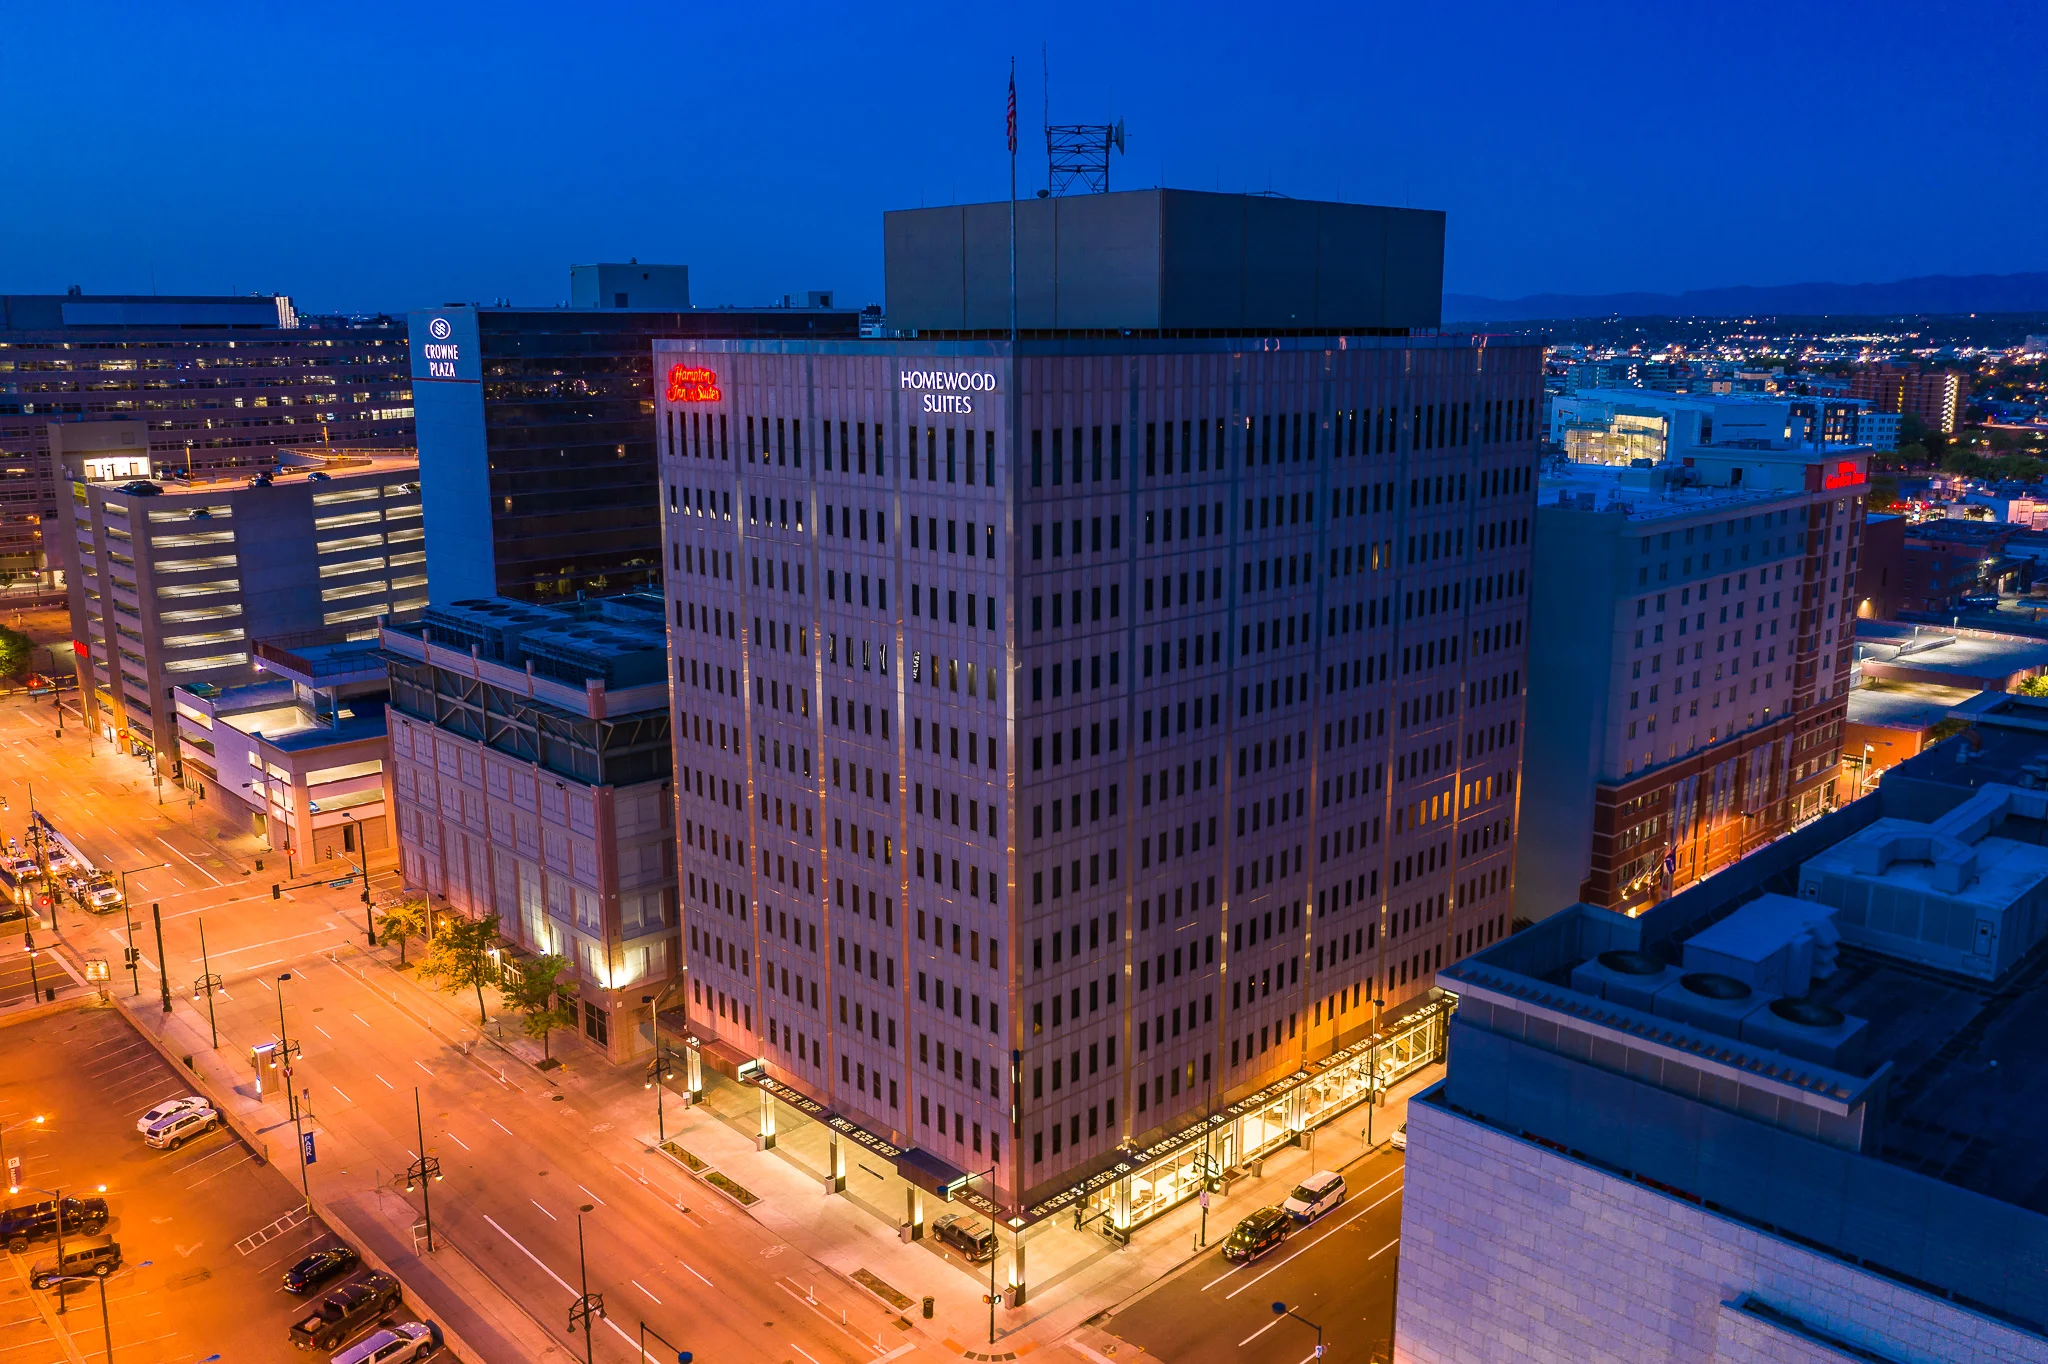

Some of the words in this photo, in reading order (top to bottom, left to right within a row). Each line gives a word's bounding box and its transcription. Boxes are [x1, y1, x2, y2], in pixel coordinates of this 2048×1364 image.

[425, 344, 459, 360] CROWNE
[430, 362, 456, 377] PLAZA
[668, 363, 716, 385] Hampton
[901, 371, 996, 391] HOMEWOOD
[667, 385, 688, 401] Inn
[697, 384, 721, 401] Suites
[923, 394, 972, 414] SUITES
[304, 1135, 312, 1157] PARK
